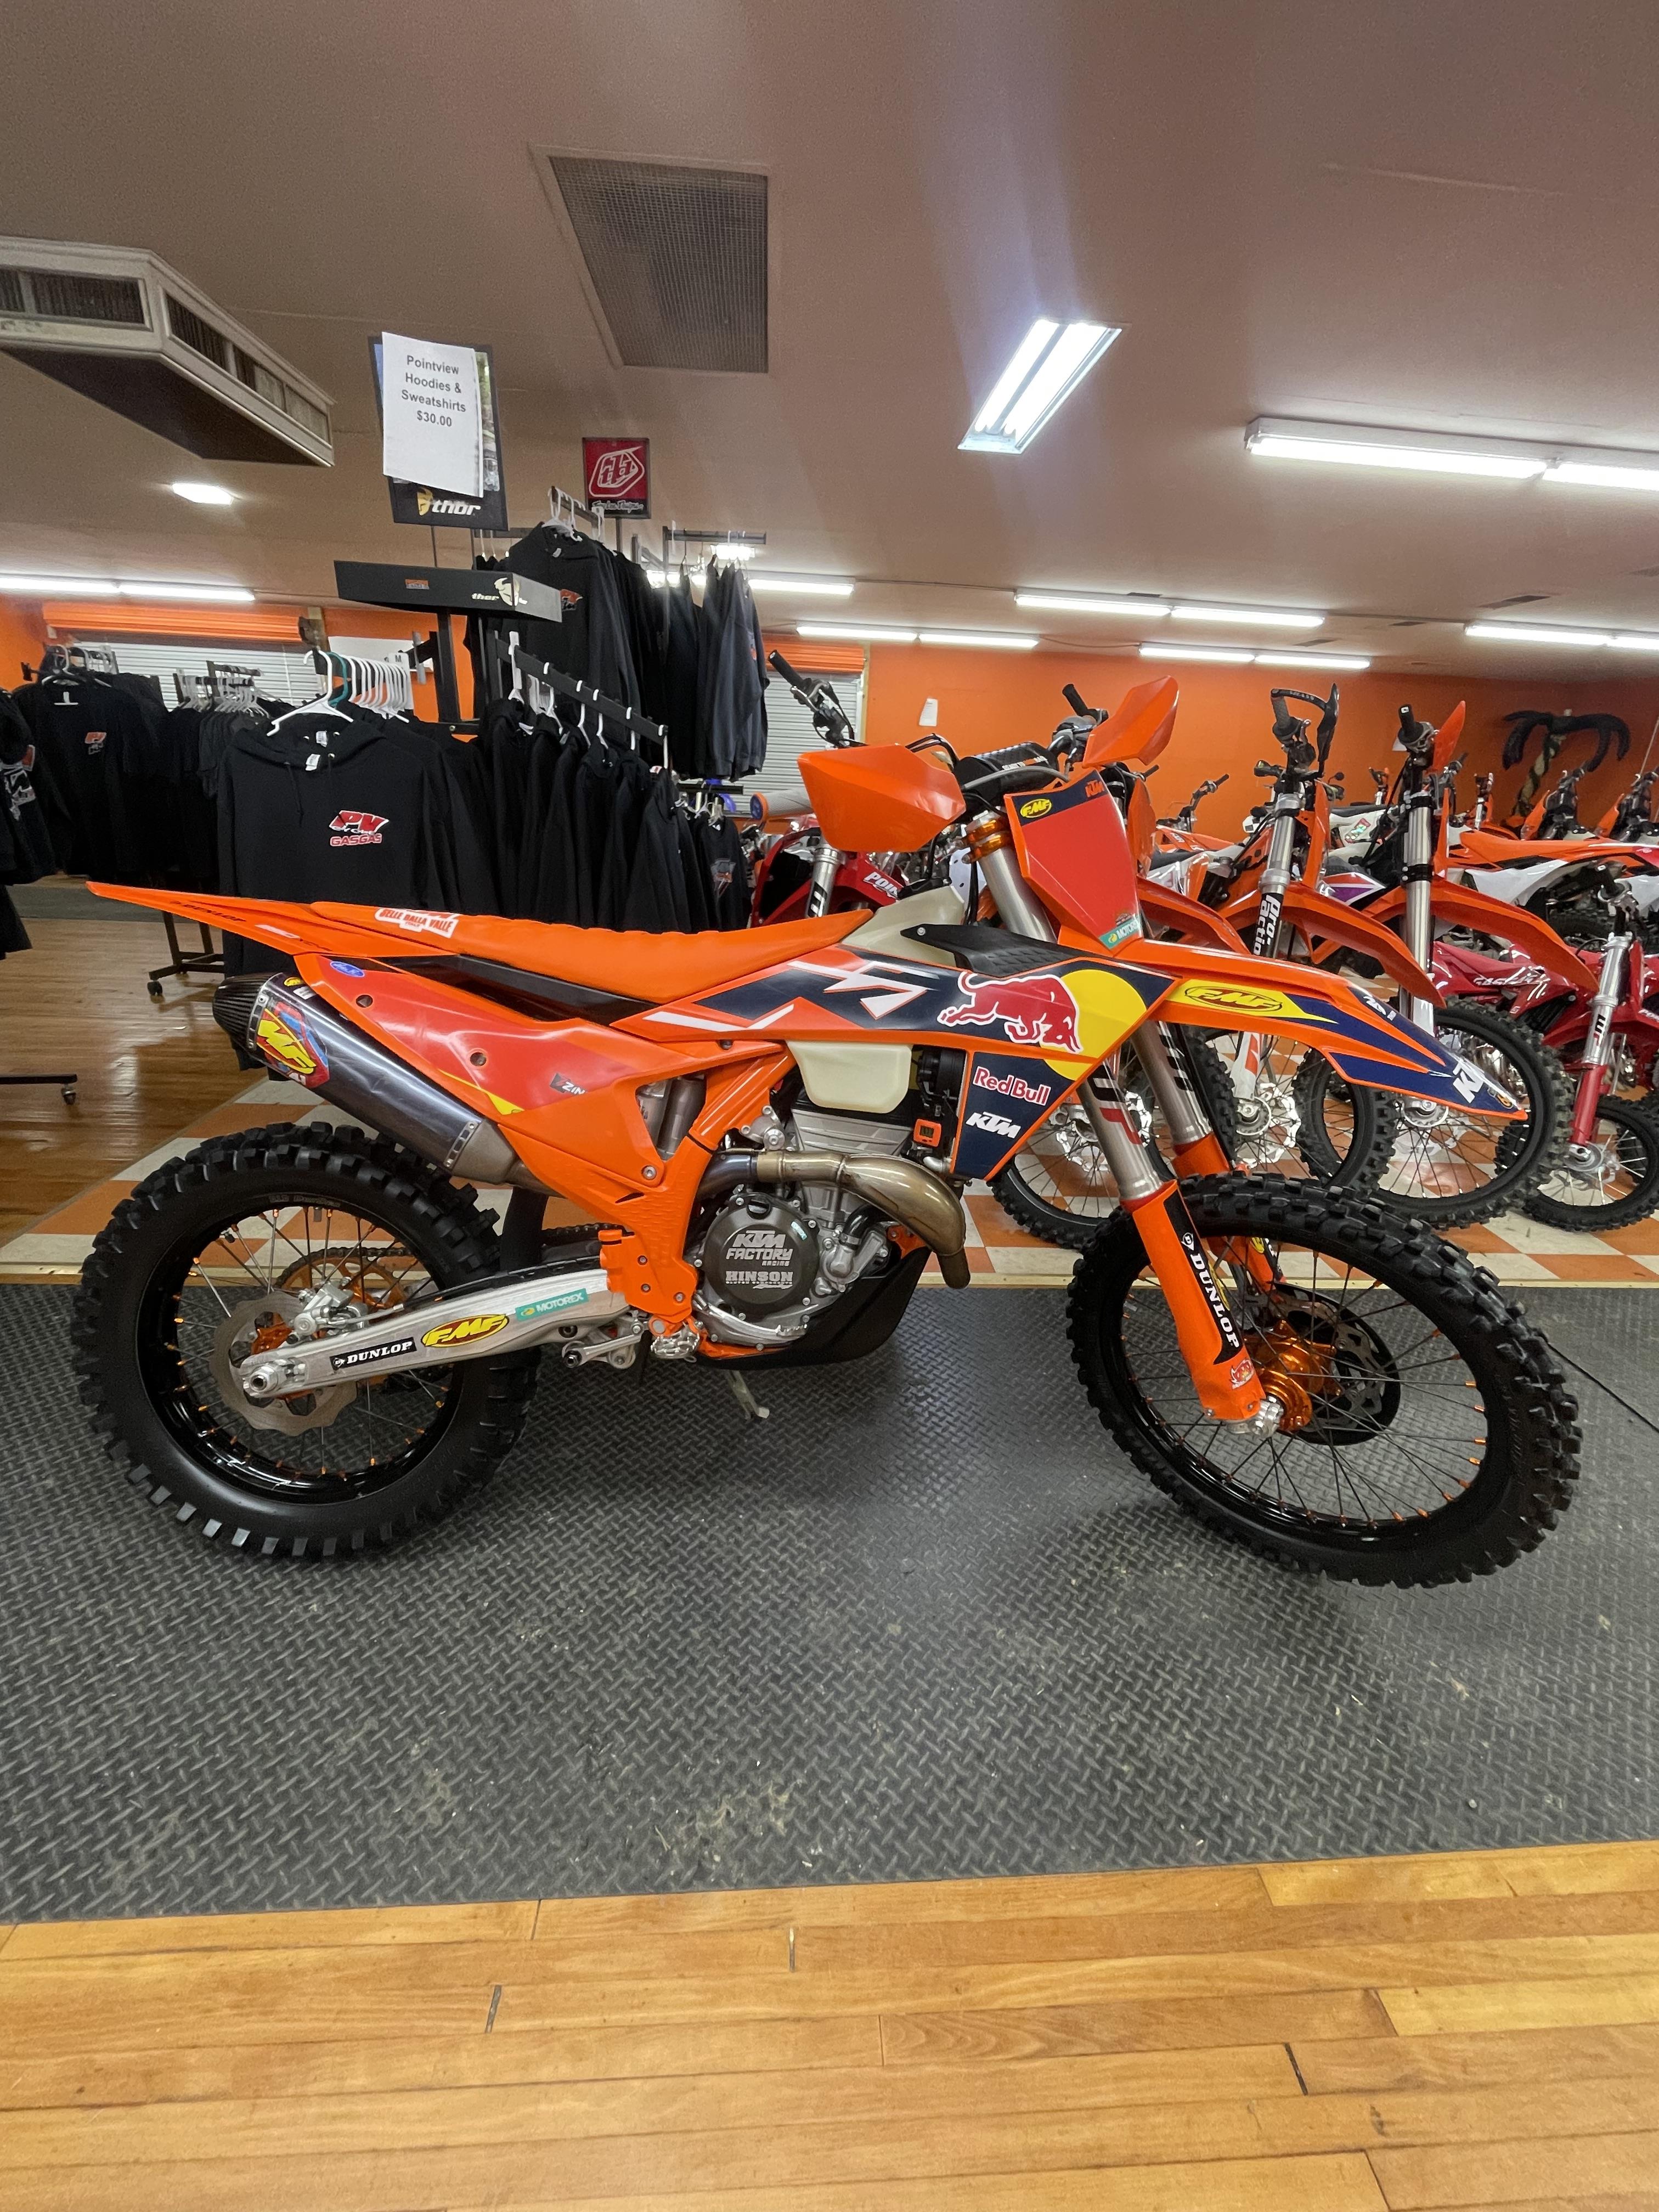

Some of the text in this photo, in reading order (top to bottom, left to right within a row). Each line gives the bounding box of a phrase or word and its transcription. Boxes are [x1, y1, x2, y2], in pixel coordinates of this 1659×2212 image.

[407, 354, 460, 375] Pointview
[405, 372, 462, 393] Hoodies &
[401, 389, 466, 412] Sweatshirts
[416, 410, 452, 427] $30.00
[432, 499, 481, 516] thor
[471, 592, 499, 601] thor
[1021, 799, 1052, 817] FMF
[330, 833, 382, 847] GASGAS
[1186, 988, 1283, 1008] FMF
[973, 1066, 1052, 1106] Red Bull
[965, 1111, 1022, 1139] KTM
[732, 1230, 786, 1248] KTM
[725, 1248, 793, 1260] FACTORY
[725, 1271, 793, 1282] HINSON
[535, 1293, 584, 1312] MOTOREX
[1190, 1252, 1240, 1348] DUNLOP
[425, 1314, 506, 1346] FMF
[346, 1341, 413, 1364] DUNLOP
